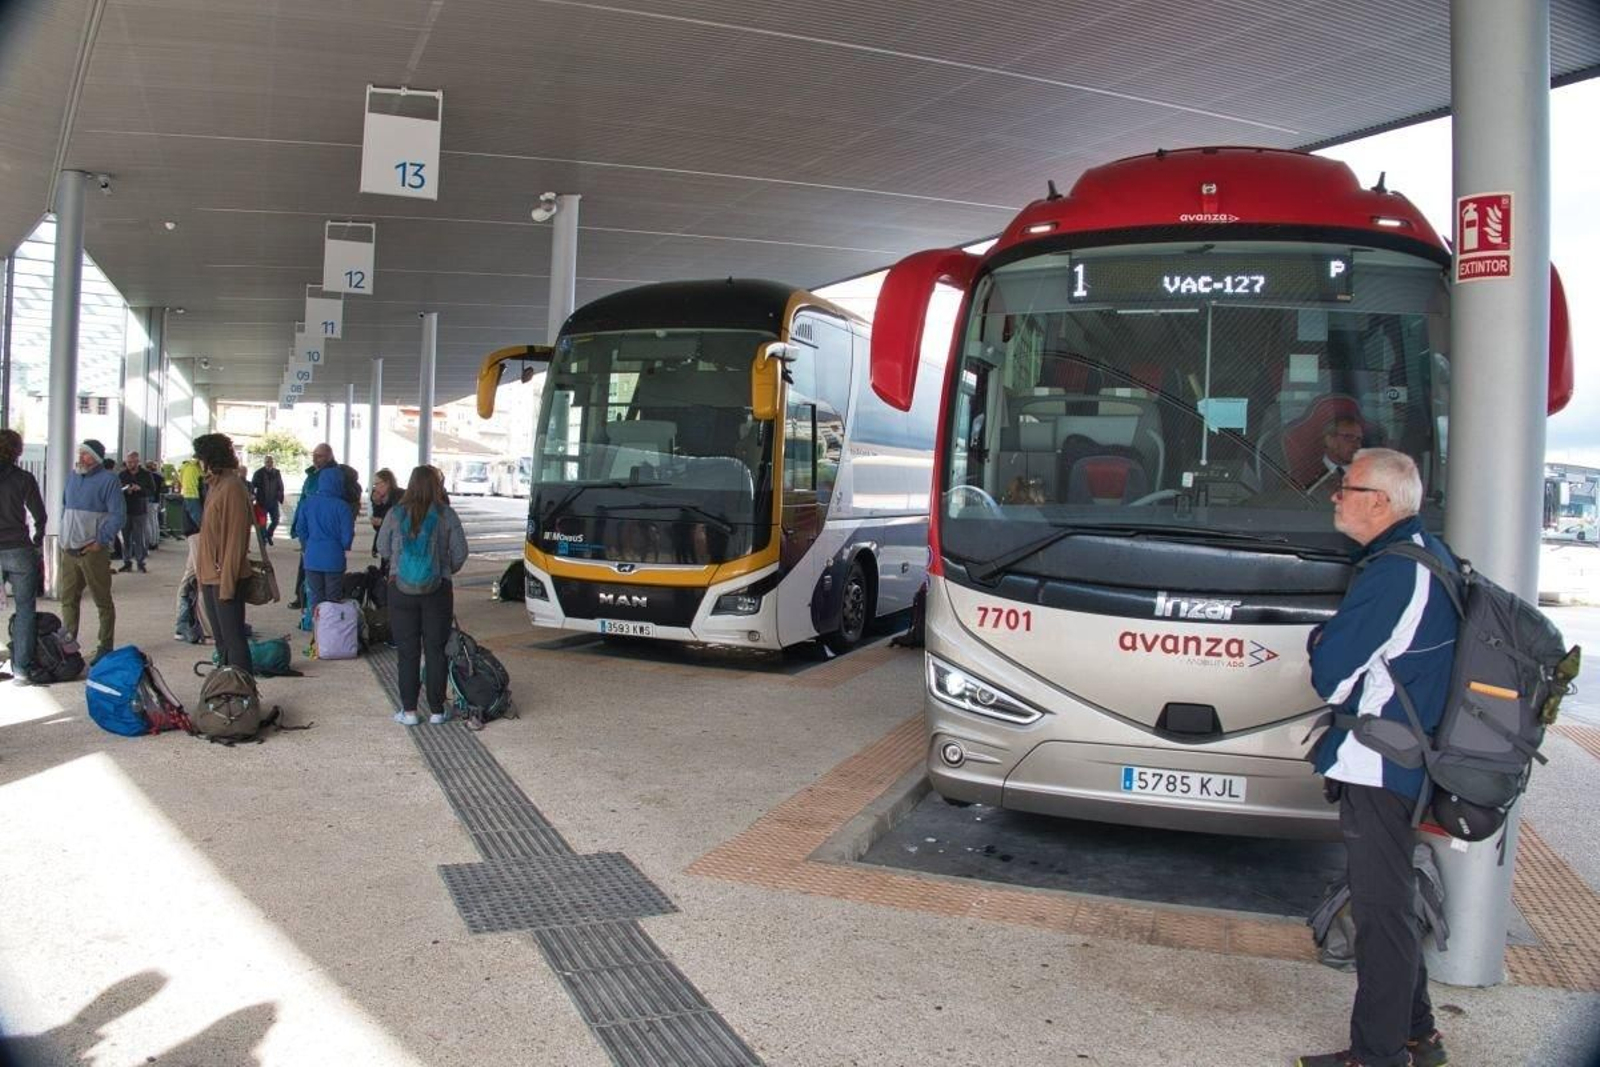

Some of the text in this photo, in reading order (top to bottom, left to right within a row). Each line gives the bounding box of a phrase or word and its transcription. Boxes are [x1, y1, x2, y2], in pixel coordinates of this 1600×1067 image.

[394, 161, 426, 189] 13
[1179, 213, 1227, 222] avanza
[1460, 259, 1508, 275] EXTINTOR
[344, 270, 365, 289] 12
[1073, 260, 1345, 297] 1 VAC-127 P
[321, 321, 335, 335] 11
[307, 351, 320, 362] 10
[296, 370, 310, 381] 09
[290, 384, 302, 393] 08
[286, 394, 297, 403] 07
[599, 592, 648, 608] MAN
[1154, 590, 1242, 621] Irizar
[977, 606, 1031, 631] 7701
[607, 622, 630, 634] 3593
[1119, 631, 1245, 659] avanza
[1226, 660, 1245, 668] ADO
[1137, 771, 1240, 798] 5785 KJL
